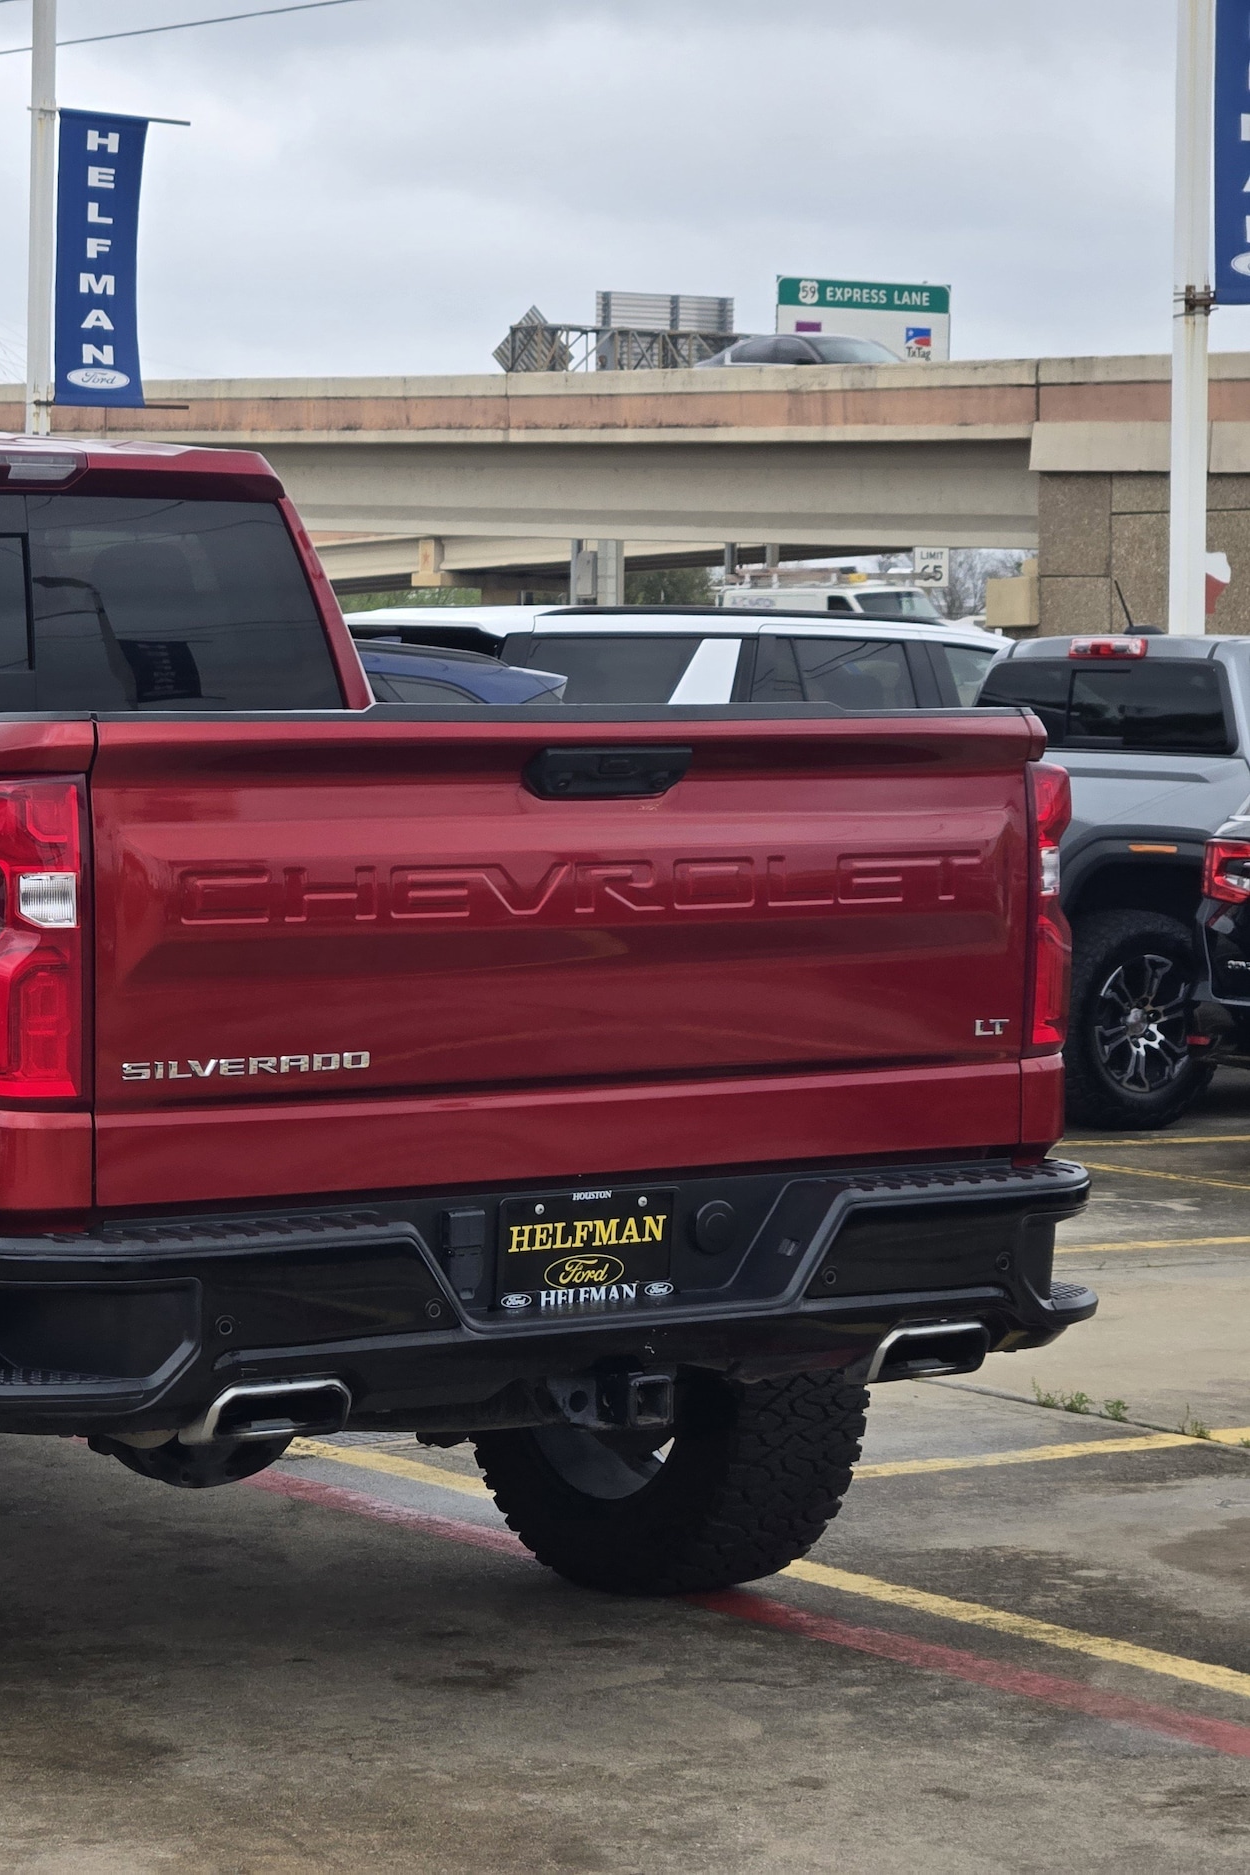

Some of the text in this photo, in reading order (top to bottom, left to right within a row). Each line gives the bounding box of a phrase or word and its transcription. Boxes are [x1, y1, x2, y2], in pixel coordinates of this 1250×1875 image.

[79, 129, 120, 366] HELFMAN
[801, 285, 930, 306] 59 EXPRESS LANE
[906, 346, 931, 361] TxTag
[81, 371, 116, 385] Ford
[920, 551, 944, 560] LIMIT
[180, 849, 983, 924] CHEVROLET
[975, 1018, 1010, 1036] LT
[121, 1051, 371, 1081] SILVERADO
[572, 1190, 612, 1201] HOUSTON
[508, 1214, 667, 1253] HELFMAN
[559, 1258, 610, 1284] Ford
